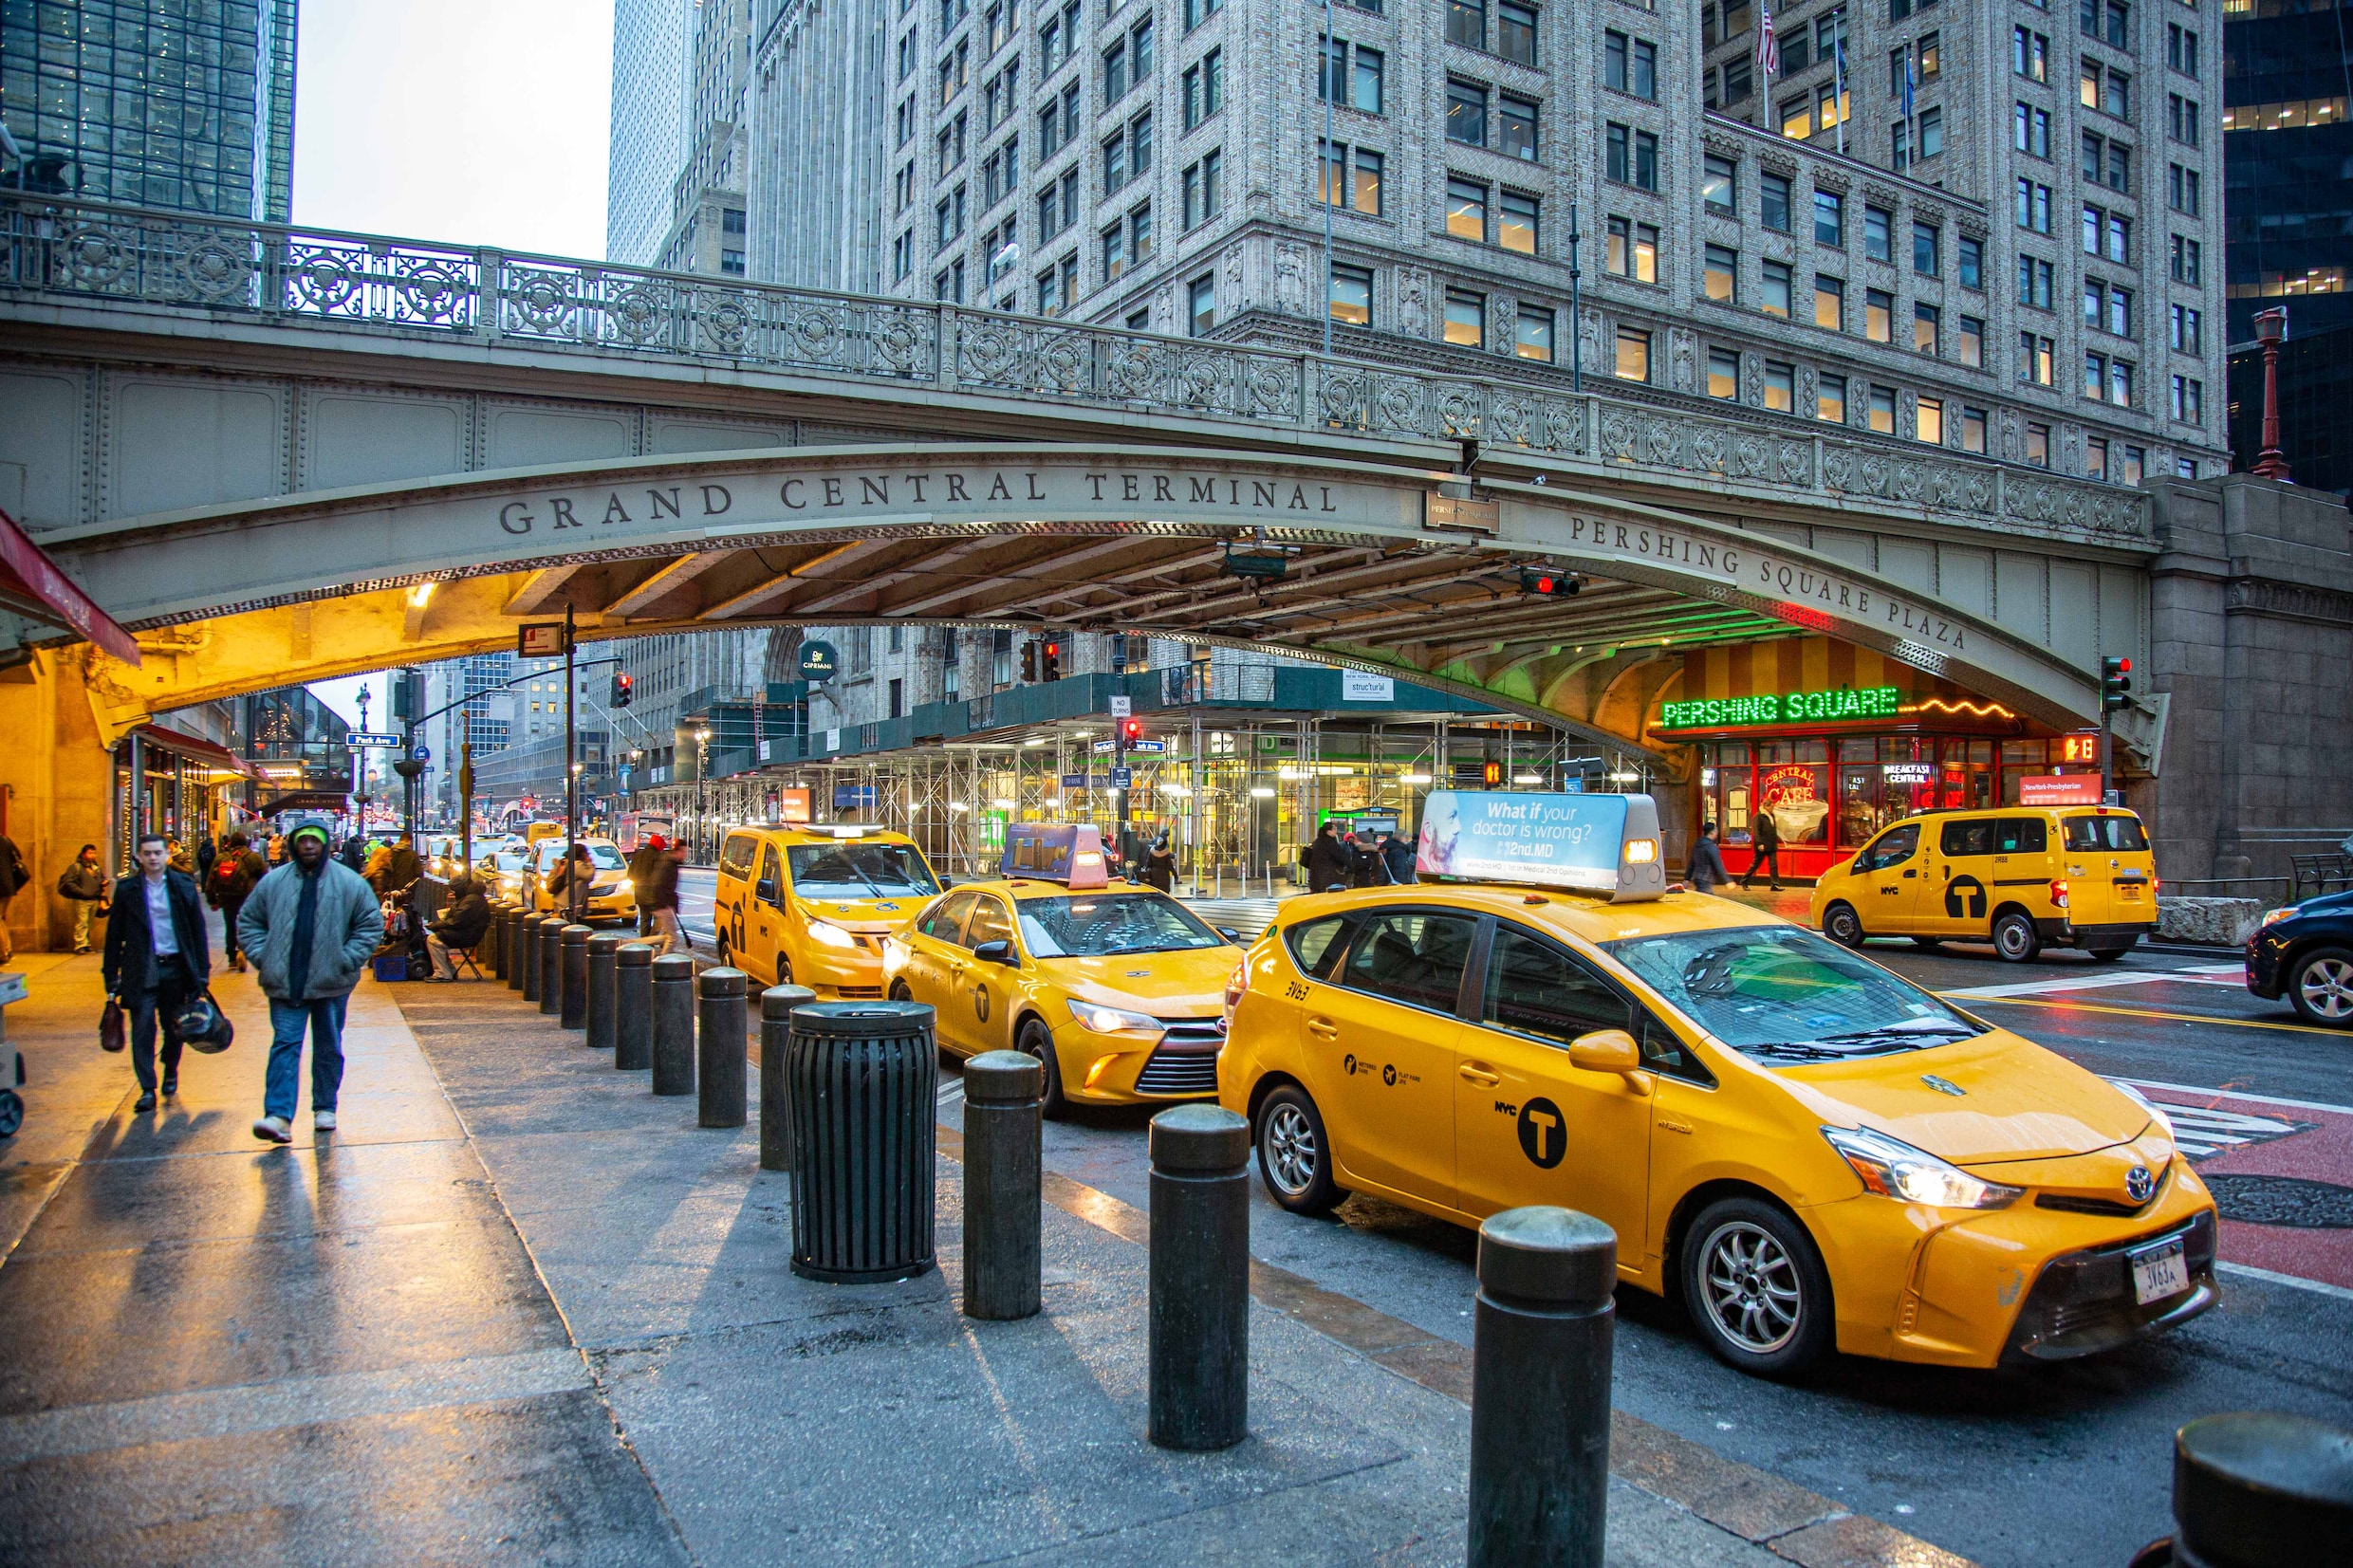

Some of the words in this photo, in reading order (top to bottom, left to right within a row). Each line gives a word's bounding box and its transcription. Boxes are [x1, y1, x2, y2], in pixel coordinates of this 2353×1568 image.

[499, 484, 732, 535] GRAND
[780, 472, 1047, 509] CENTRAL
[1085, 473, 1337, 513] TERMINAL
[1571, 517, 1739, 574] PERSHING
[1760, 561, 1870, 613] SQUARE
[1888, 602, 1965, 650] PLAZA
[1663, 695, 1778, 727] PERSHING
[1786, 687, 1897, 718] SQUARE
[355, 736, 374, 745] Park
[1764, 766, 1814, 787] CENTRAL
[1883, 766, 1930, 775] BREAKFAST
[1889, 775, 1926, 784] CENTRAL
[1767, 786, 1814, 805] CAFE
[2025, 783, 2082, 791] NewYork-Presbyterian
[1487, 802, 1526, 820] What
[1529, 803, 1543, 820] if
[1542, 807, 1577, 823] your
[1473, 820, 1517, 837] doctor
[1520, 822, 1531, 839] is
[1534, 824, 1592, 843] wrong?
[1510, 841, 1553, 858] 2nd.MD
[1523, 863, 1546, 874] Medical
[1547, 865, 1558, 875] 2nd
[1559, 867, 1586, 877] Opinions
[1285, 981, 1309, 1002] 3V63
[1409, 1075, 1421, 1083] FARE
[1494, 1100, 1517, 1116] NYC
[1529, 1109, 1557, 1161] T
[2145, 1261, 2177, 1289] 3V63A
